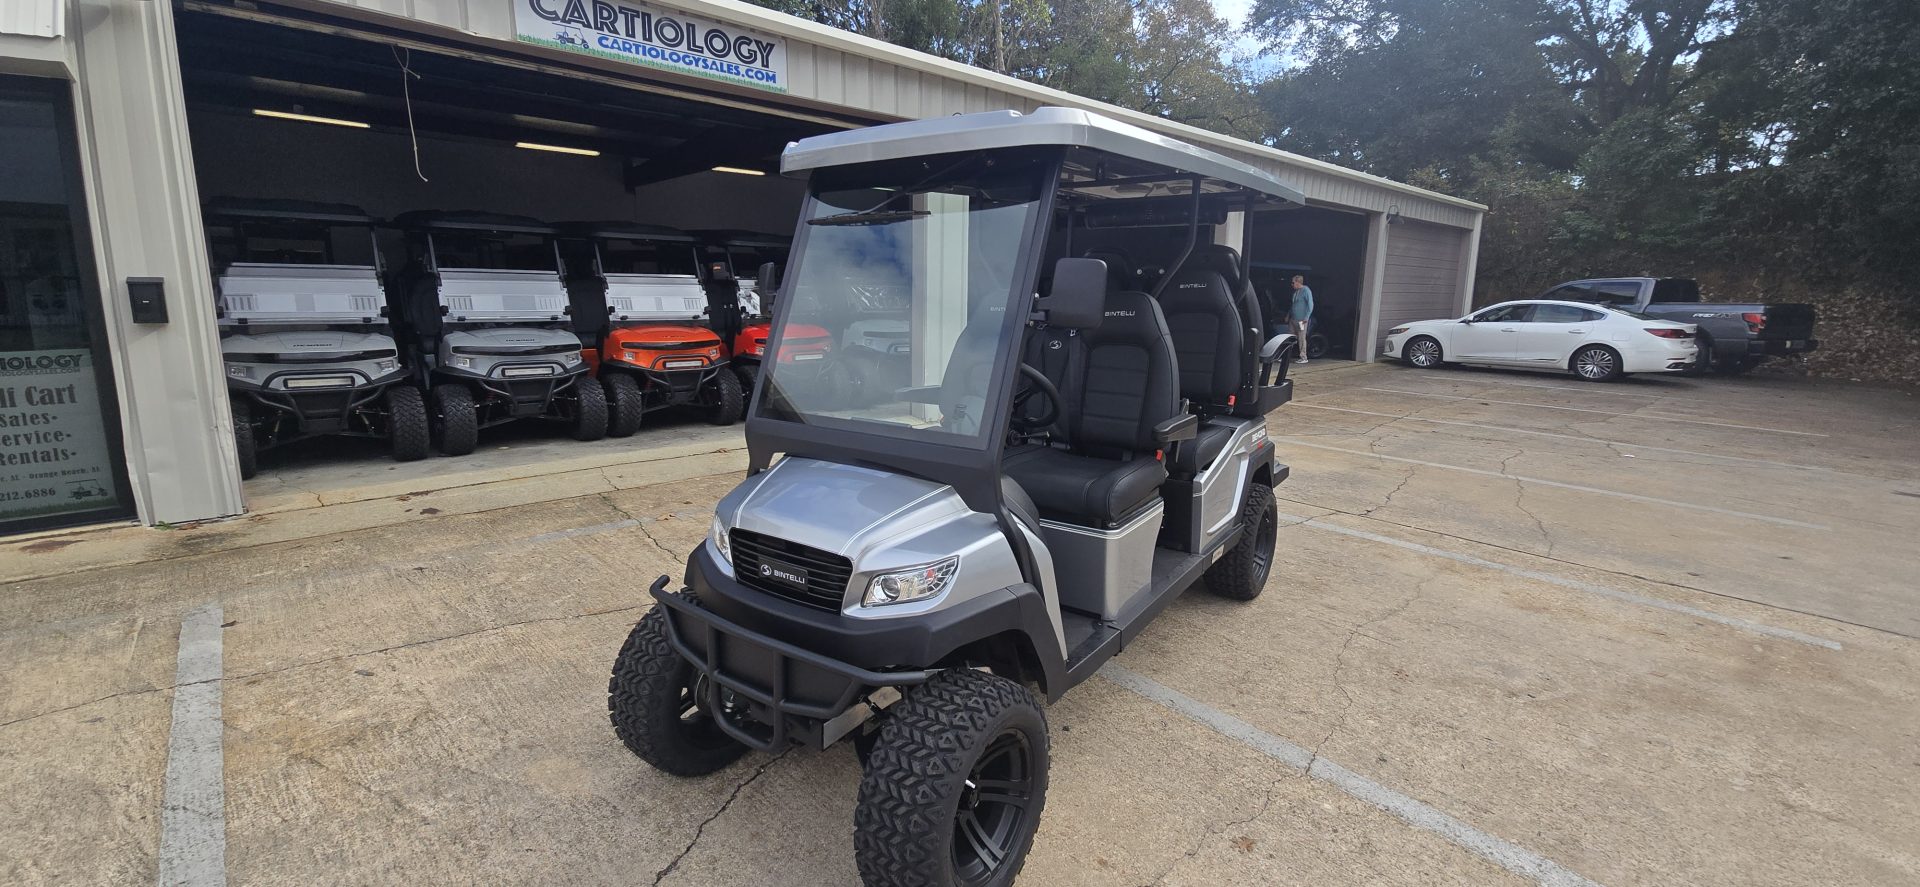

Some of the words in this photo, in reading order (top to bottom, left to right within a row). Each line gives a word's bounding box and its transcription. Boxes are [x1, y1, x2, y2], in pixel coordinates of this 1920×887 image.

[529, 0, 776, 68] CARTIOLOGY
[597, 35, 777, 84] CARTIOLOGYSALES.COM
[1104, 309, 1136, 317] BINTELLI
[25, 384, 78, 406] Cart
[0, 430, 71, 447] ervice-
[774, 569, 805, 584] BINTELLI
